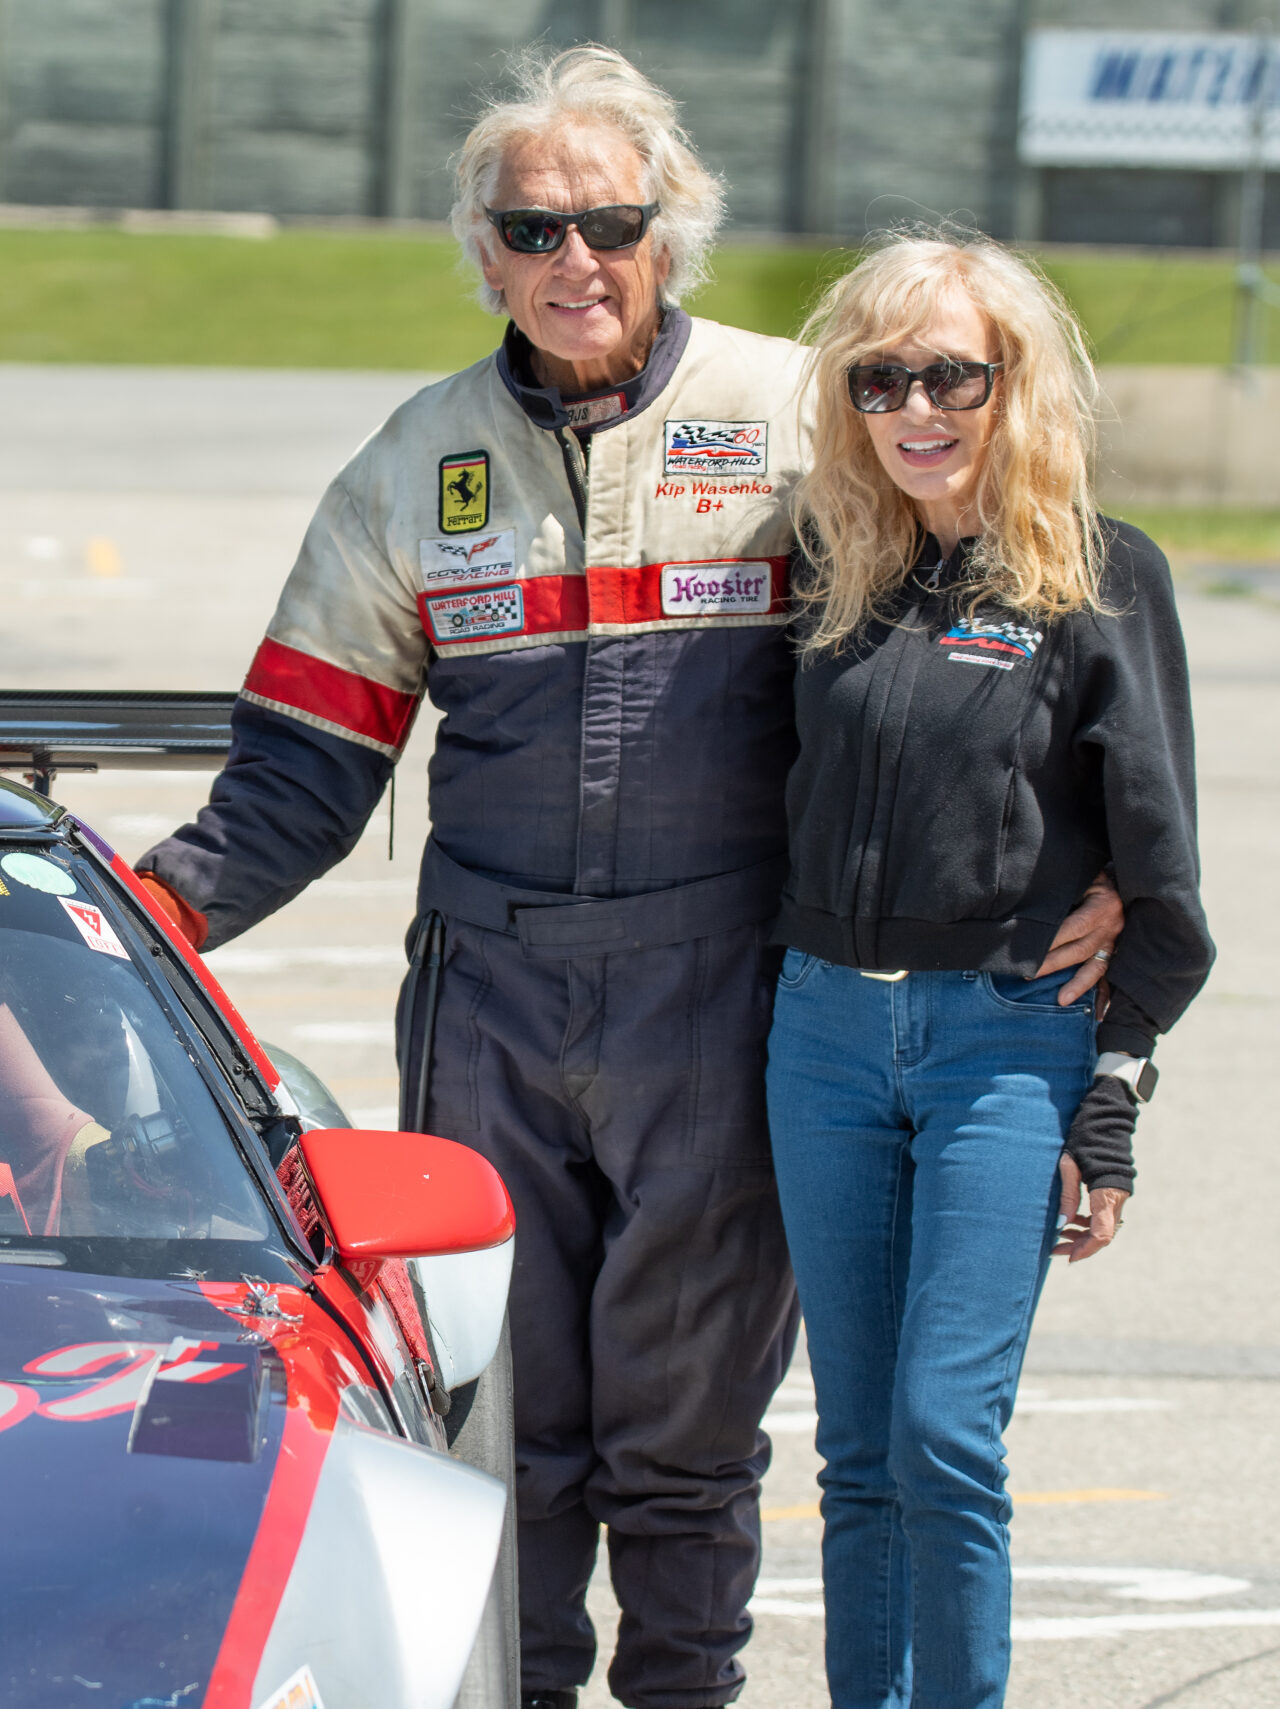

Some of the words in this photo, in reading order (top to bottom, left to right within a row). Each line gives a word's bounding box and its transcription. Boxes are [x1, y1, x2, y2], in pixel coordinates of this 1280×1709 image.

[733, 429, 760, 444] 60
[655, 482, 685, 498] Kip
[692, 481, 773, 495] Wasenko
[696, 498, 724, 513] B+
[447, 513, 483, 527] Ferrari
[427, 561, 513, 579] CORVETTE
[453, 568, 510, 582] RACING
[669, 572, 764, 602] Hoosier
[431, 594, 491, 611] WATERFORD
[494, 590, 516, 602] HILLS
[701, 596, 736, 604] RACING
[449, 626, 471, 635] ROAD
[472, 622, 506, 632] RACING
